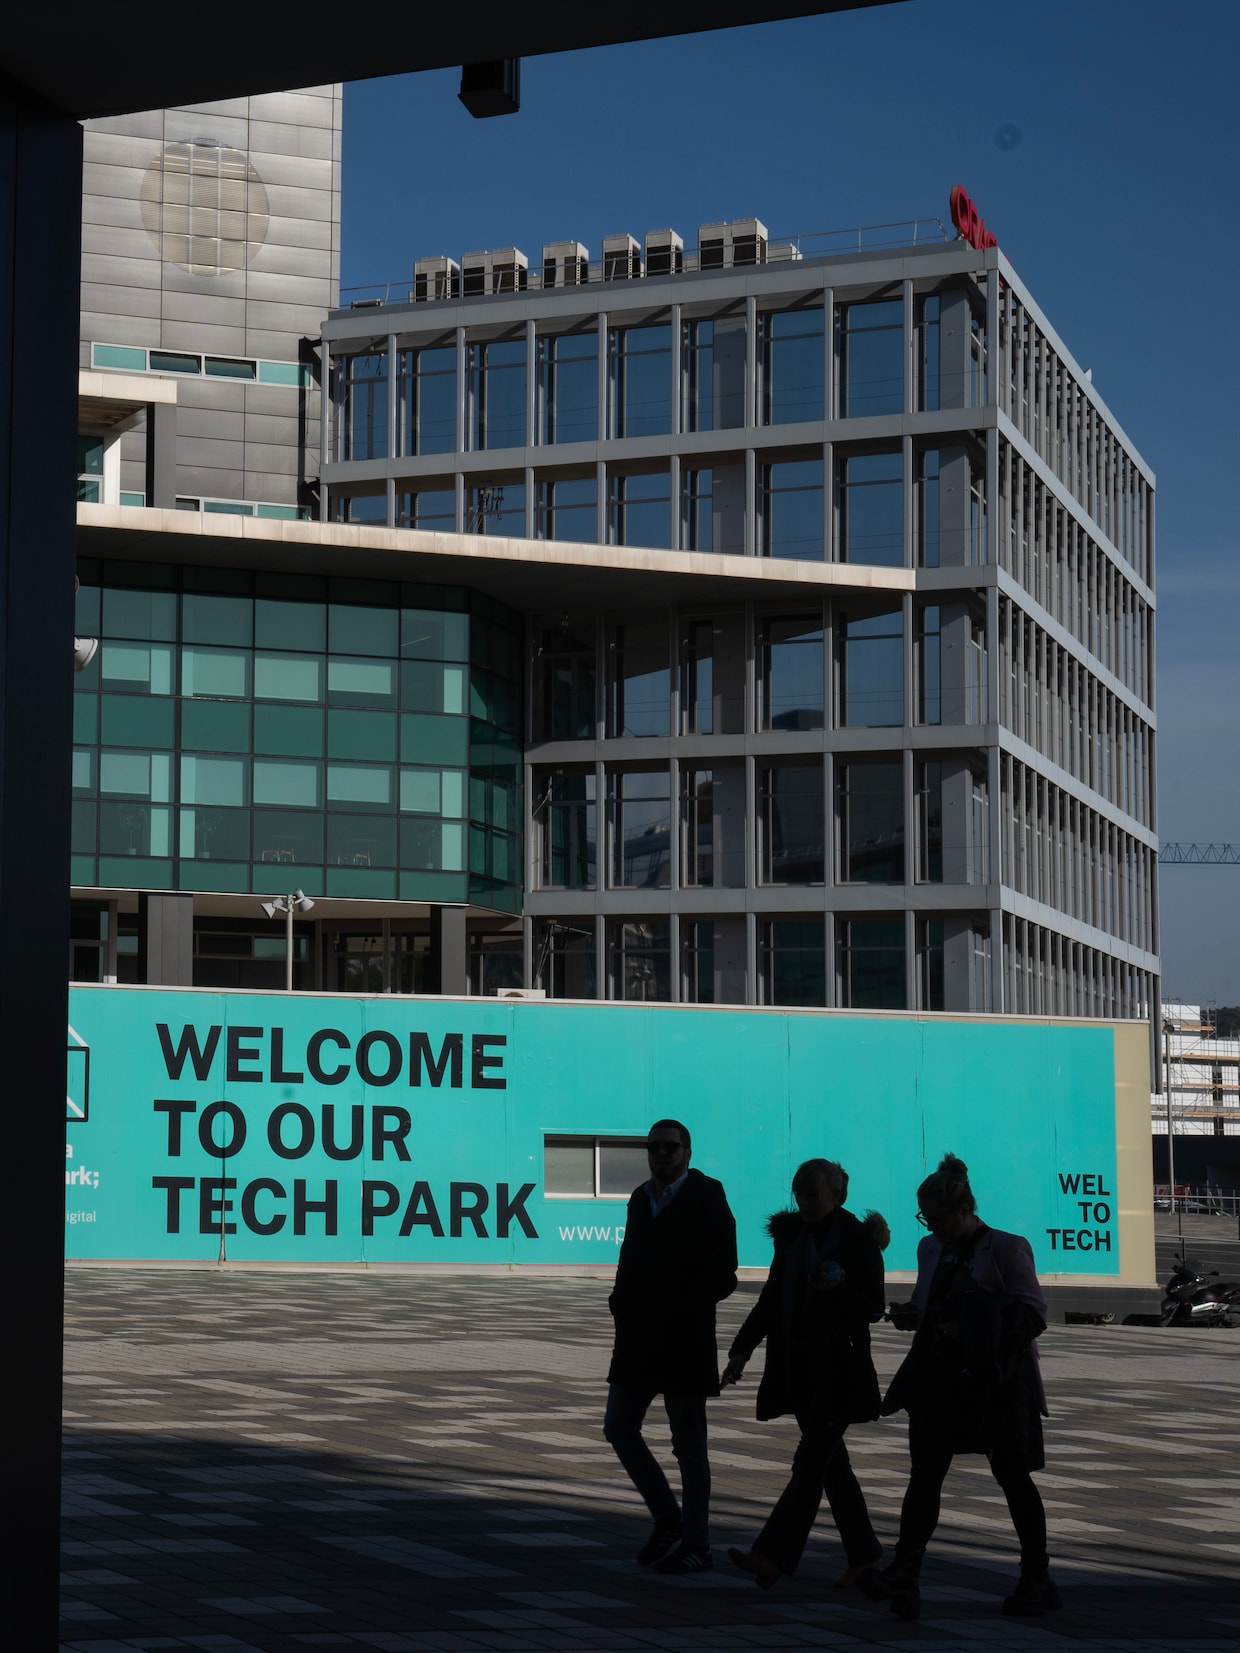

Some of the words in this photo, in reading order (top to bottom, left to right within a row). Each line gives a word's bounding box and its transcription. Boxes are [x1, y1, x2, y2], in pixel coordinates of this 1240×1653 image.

[156, 1023, 507, 1089] WELCOME
[153, 1099, 247, 1158] TO
[267, 1102, 412, 1161] OUR
[1058, 1173, 1111, 1196] WEL
[66, 1210, 97, 1224] igital
[152, 1176, 338, 1236] TECH
[361, 1180, 539, 1239] PARK
[1077, 1201, 1111, 1224] TO
[1046, 1228, 1111, 1252] TECH
